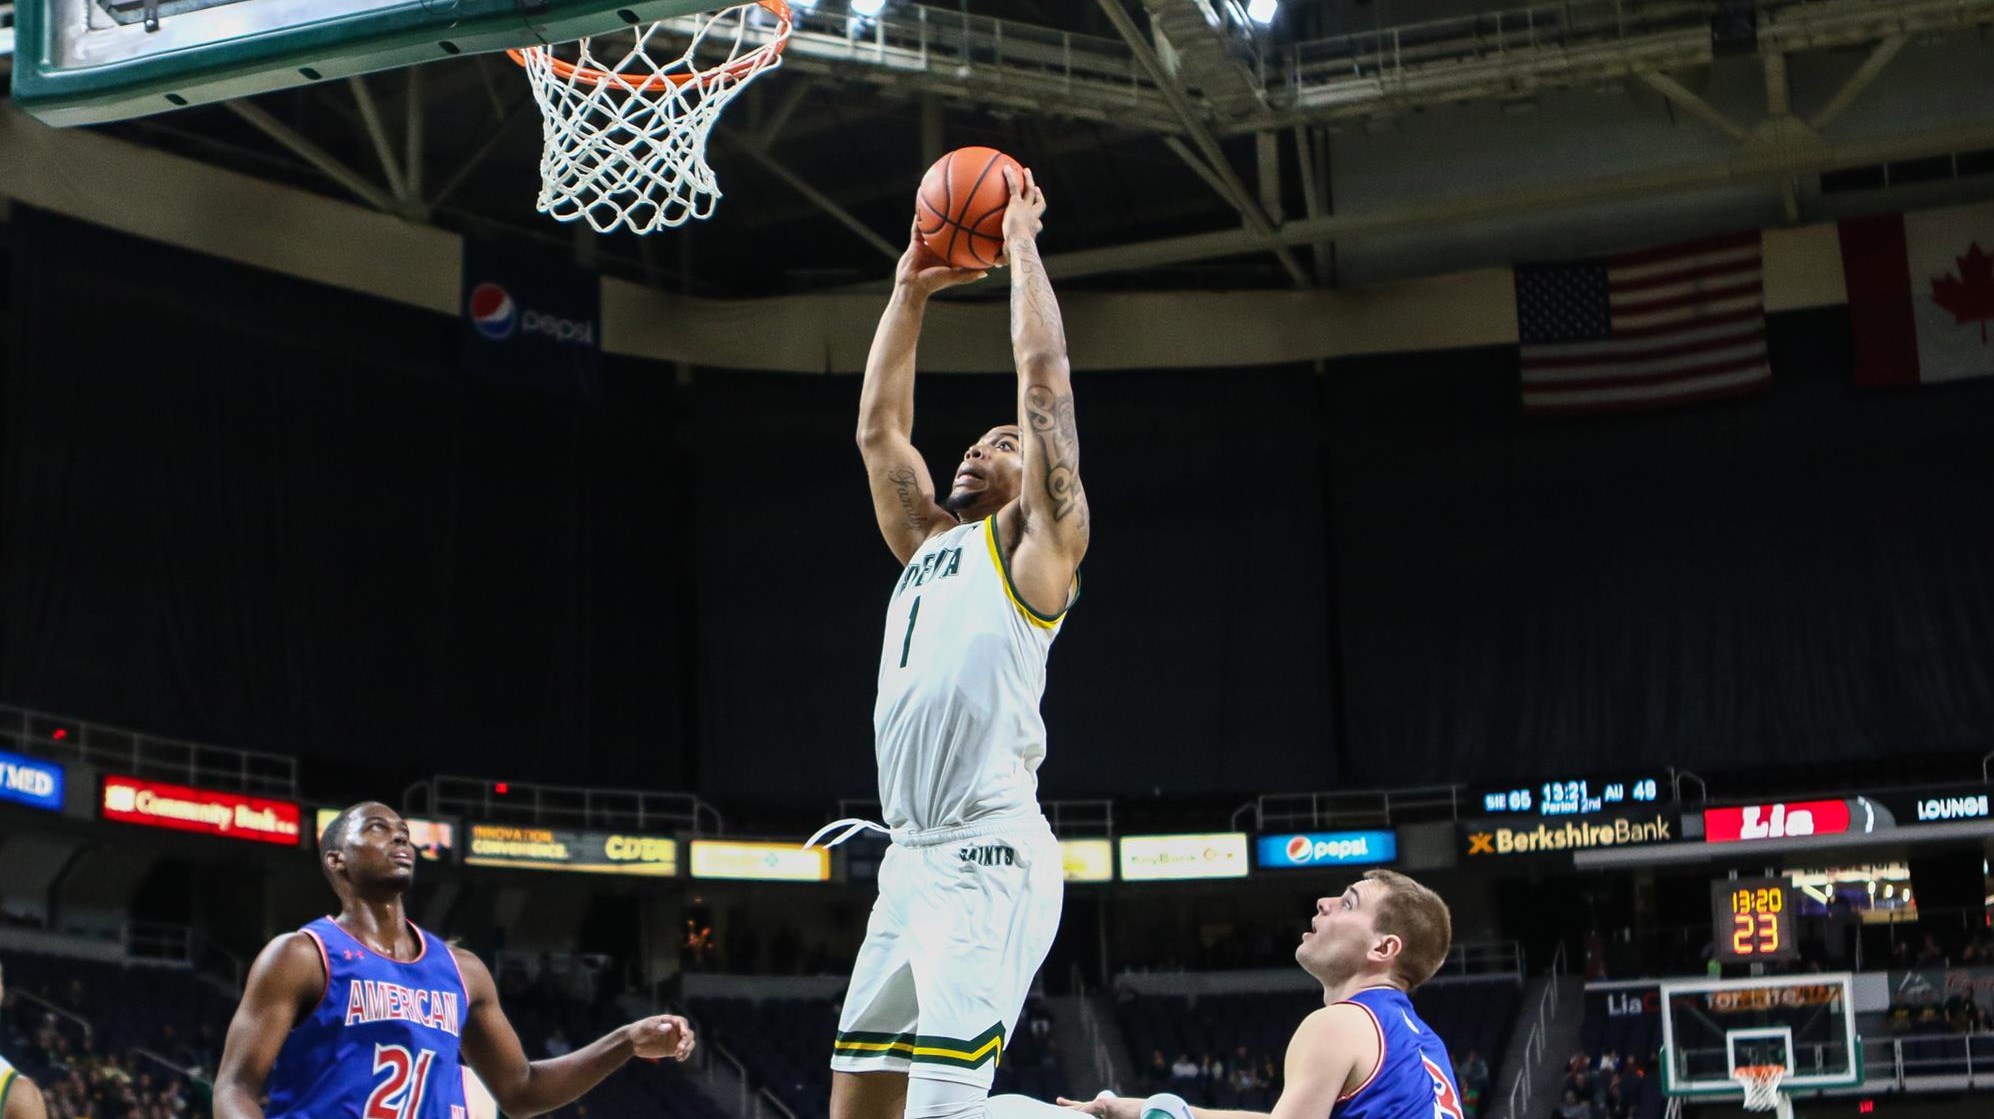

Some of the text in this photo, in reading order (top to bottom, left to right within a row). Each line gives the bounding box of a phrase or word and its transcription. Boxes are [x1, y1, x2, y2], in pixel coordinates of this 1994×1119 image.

[522, 311, 592, 343] pepsi
[899, 595, 920, 668] 1
[1541, 797, 1602, 815] Period 2nd
[1542, 781, 1588, 803] 13:21
[959, 845, 1014, 867] SAINTS
[1314, 836, 1368, 861] pepsi
[1732, 887, 1782, 914] 13:20
[1733, 912, 1778, 954] 23
[345, 980, 458, 1037] AMERICAN
[363, 1043, 435, 1119] 21
